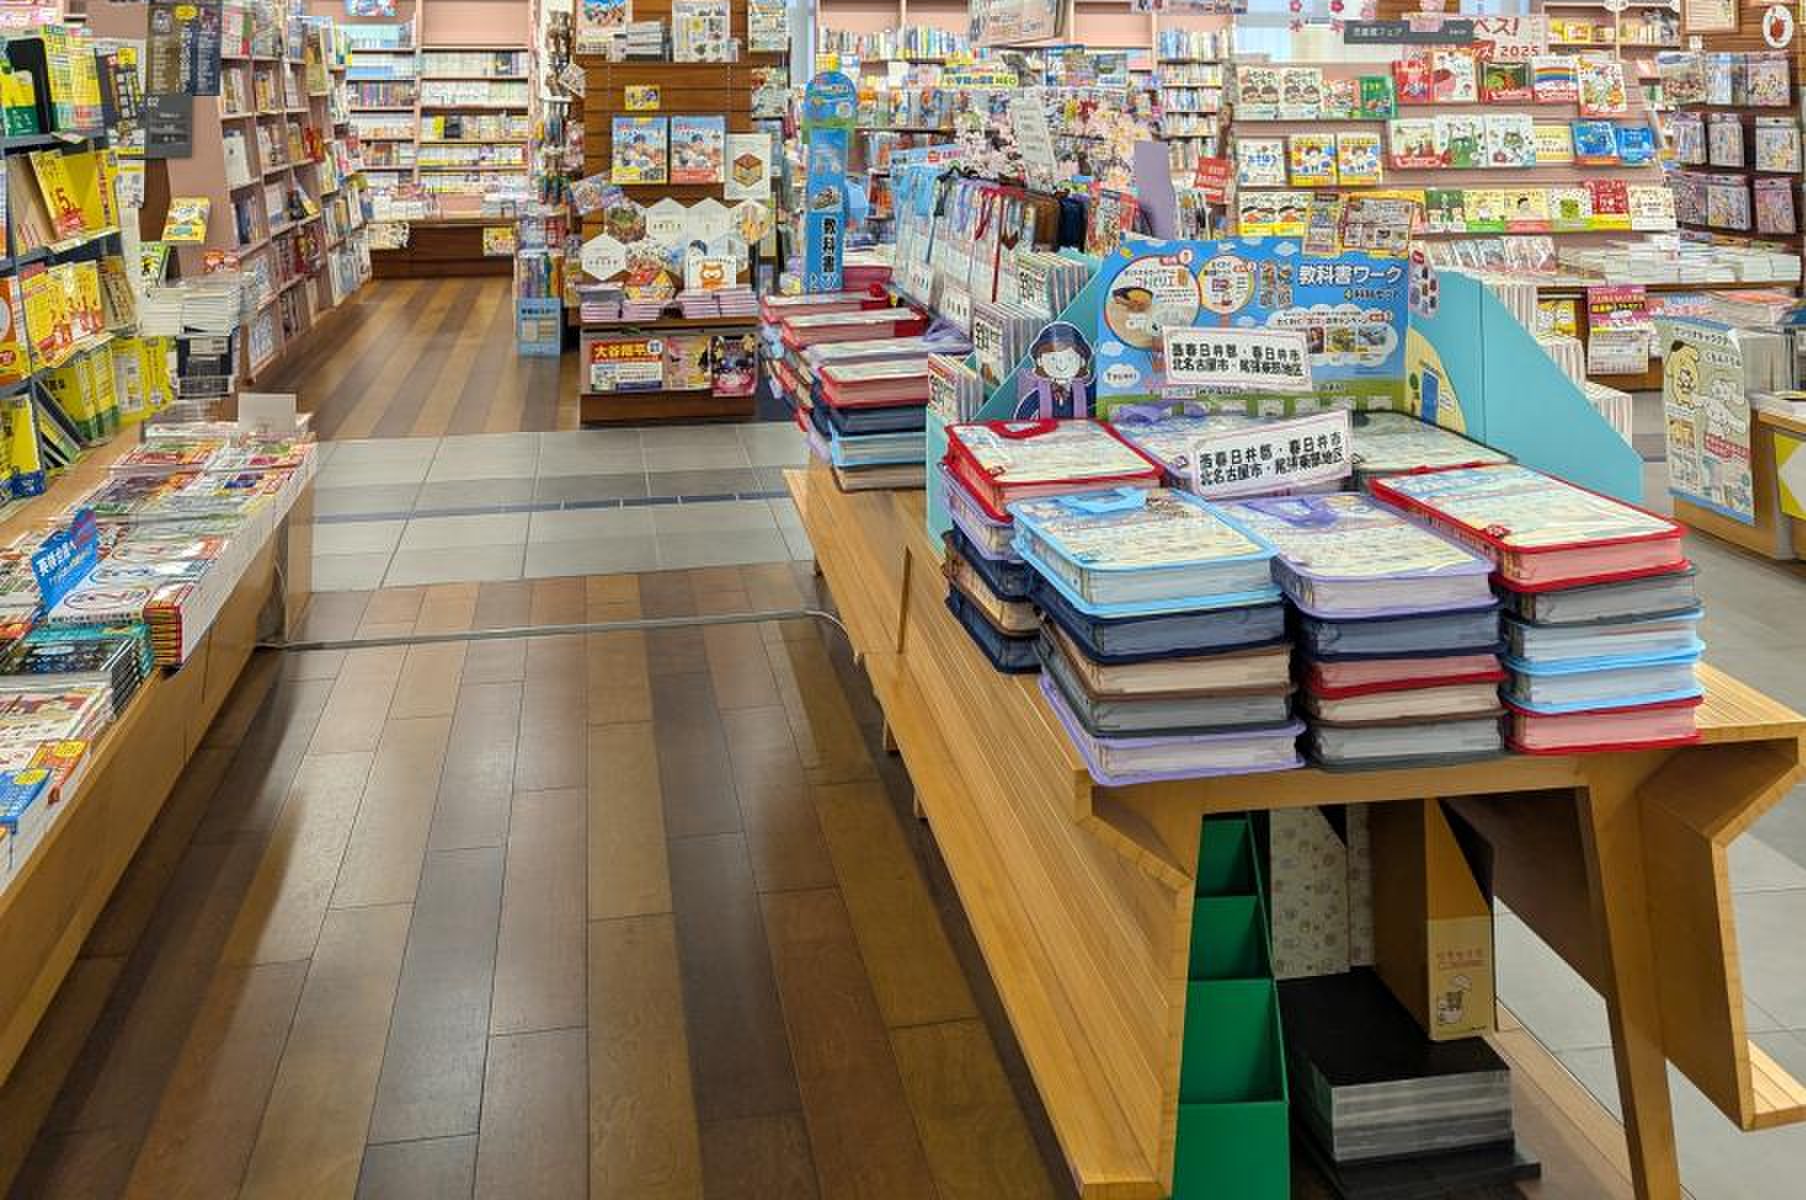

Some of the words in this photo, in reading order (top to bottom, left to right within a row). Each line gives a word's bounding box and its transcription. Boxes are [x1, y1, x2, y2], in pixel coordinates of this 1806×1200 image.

[1500, 45, 1539, 58] 2025
[1299, 263, 1402, 285] 教科書ワーク
